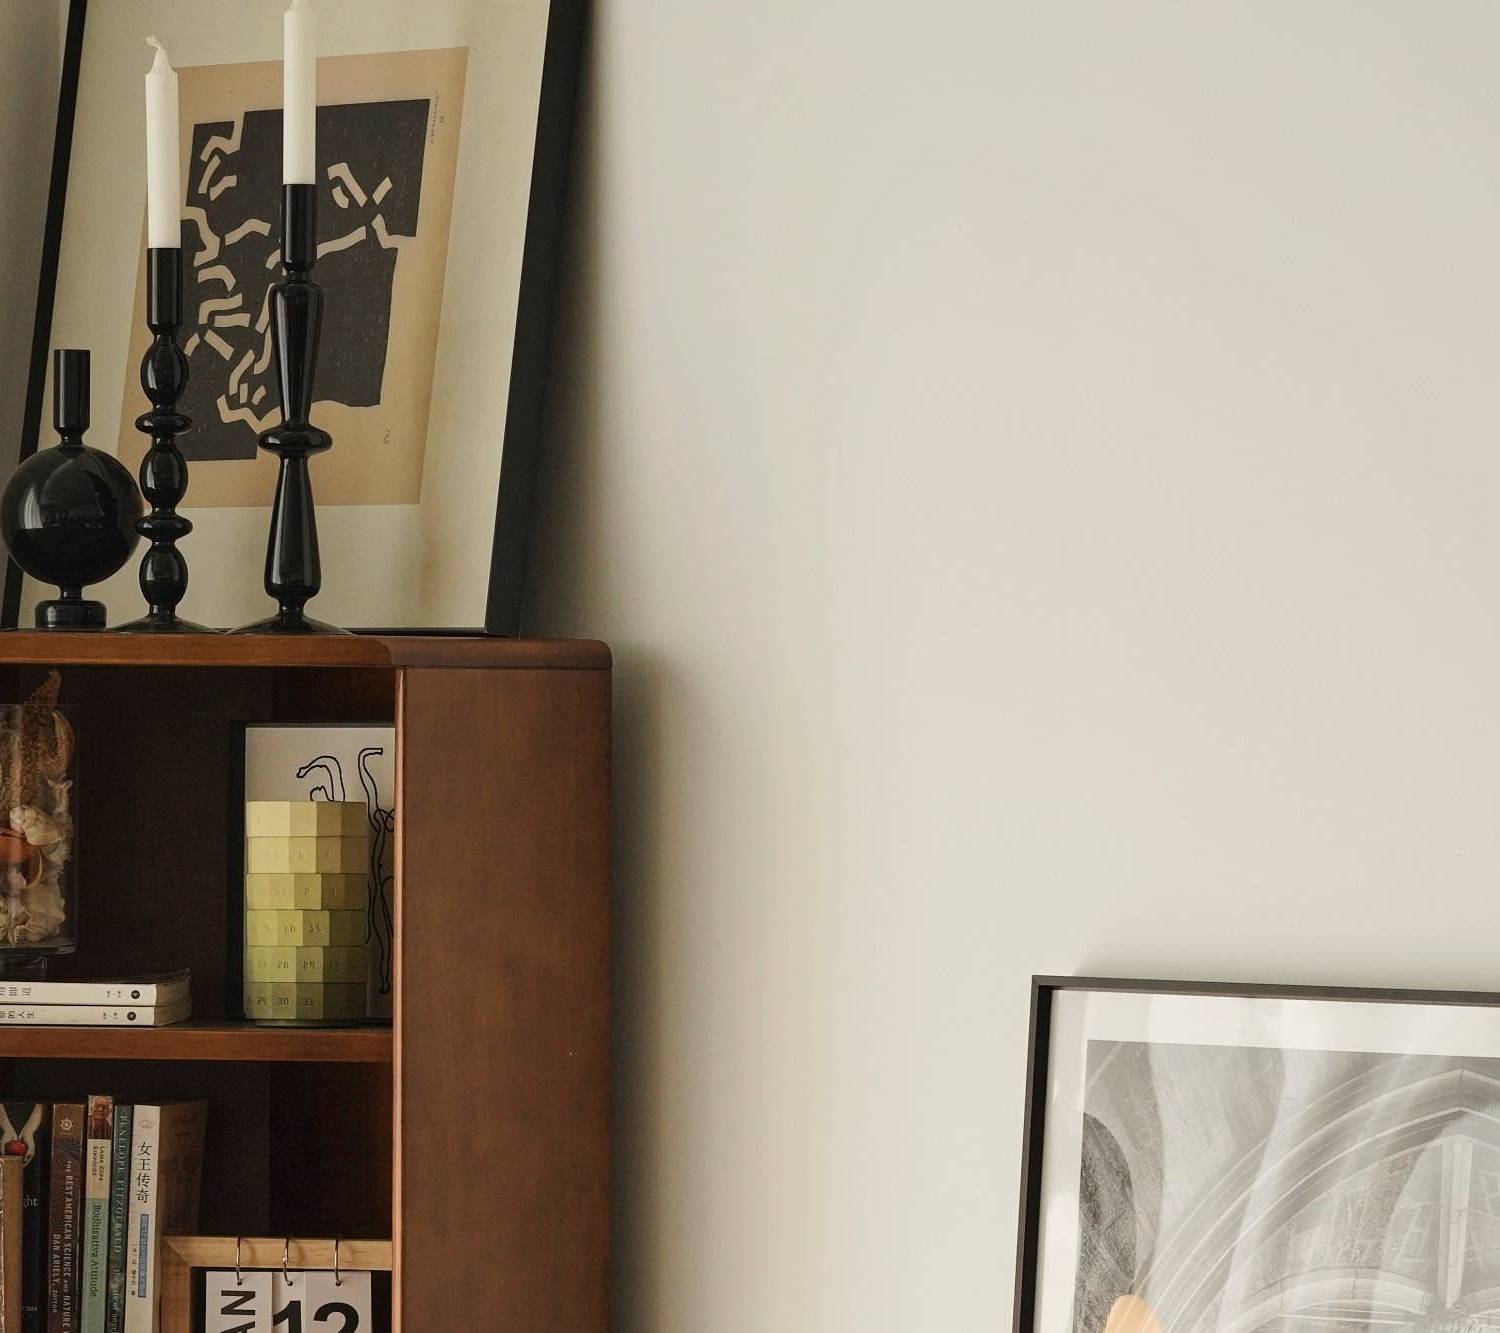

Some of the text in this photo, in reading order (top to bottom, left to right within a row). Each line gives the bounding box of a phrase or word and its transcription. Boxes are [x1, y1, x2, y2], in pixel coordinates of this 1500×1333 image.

[65, 1175, 74, 1196] BEST
[115, 1115, 127, 1253] PENELOPE FITZGERALD
[136, 1141, 153, 1204] 女王传奇
[64, 1197, 73, 1240] AMERICAN
[52, 1234, 61, 1251] DAN
[62, 1242, 72, 1278] SCIENCE
[90, 1204, 102, 1298] Bodhisattva Attitude
[51, 1254, 60, 1286] ARIELY,
[61, 1295, 71, 1328] NATURE
